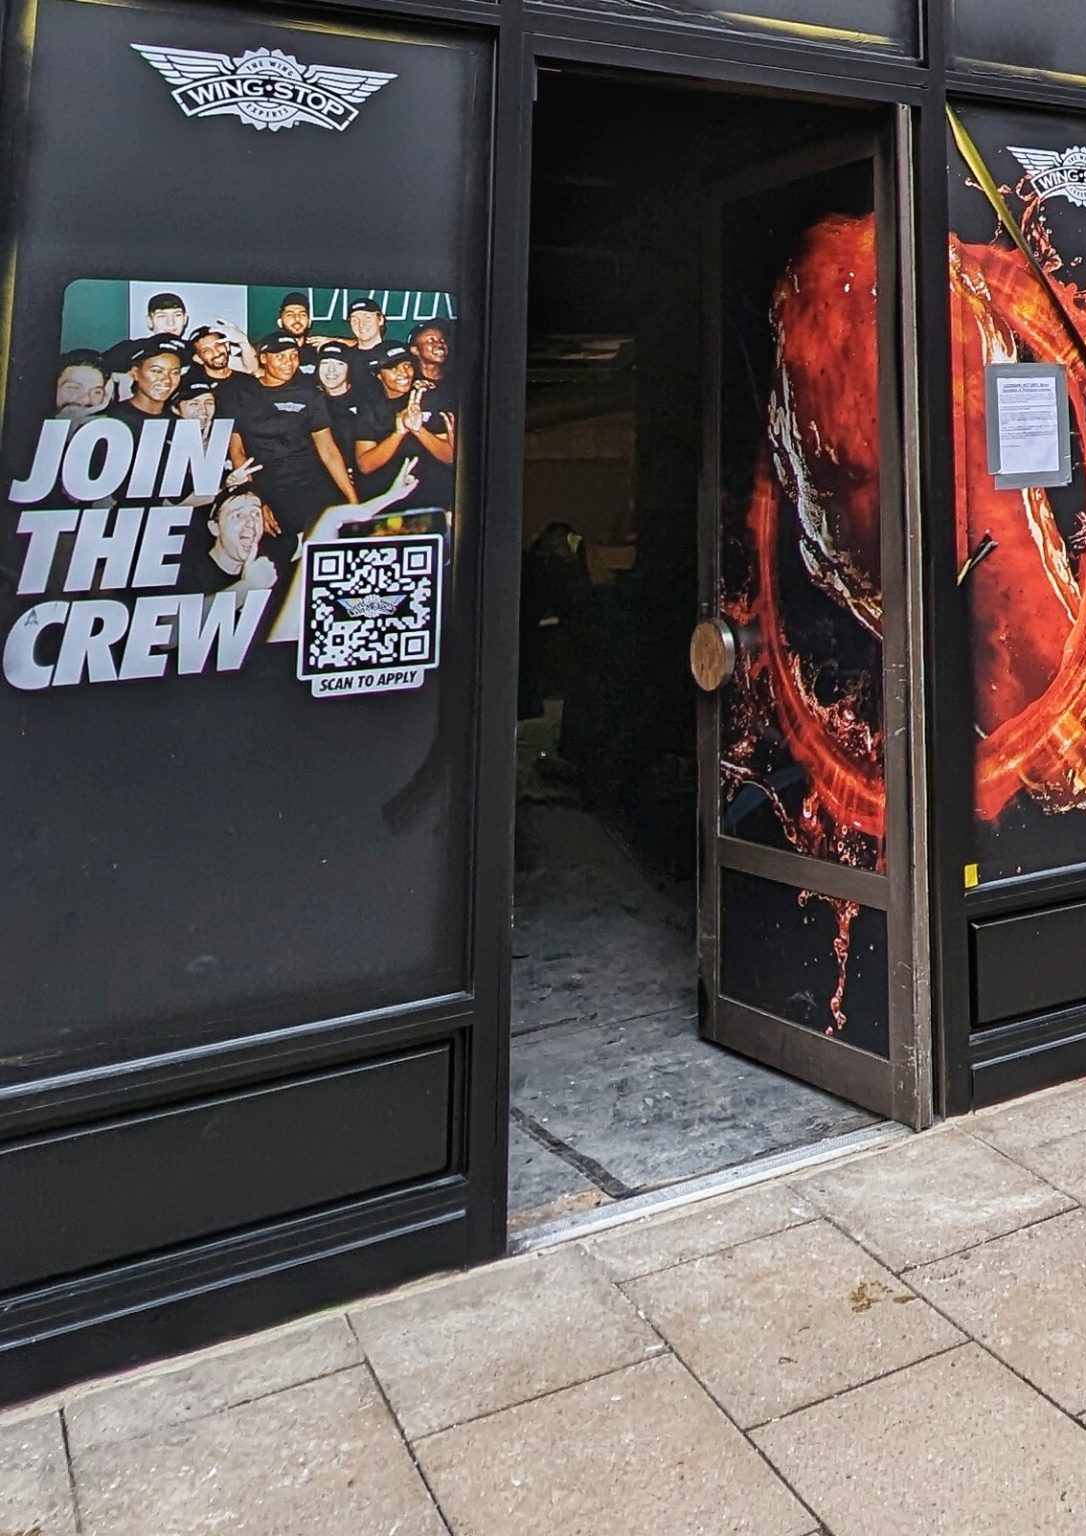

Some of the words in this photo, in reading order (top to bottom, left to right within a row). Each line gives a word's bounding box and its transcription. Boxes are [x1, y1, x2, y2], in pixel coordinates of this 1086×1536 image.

[246, 60, 264, 72] THE
[269, 60, 294, 77] WING
[8, 417, 235, 504] JOIN
[16, 506, 194, 595] THE
[3, 589, 273, 690] CREW
[319, 676, 354, 692] SCAN
[358, 674, 374, 687] TO
[377, 670, 418, 686] APPLY
